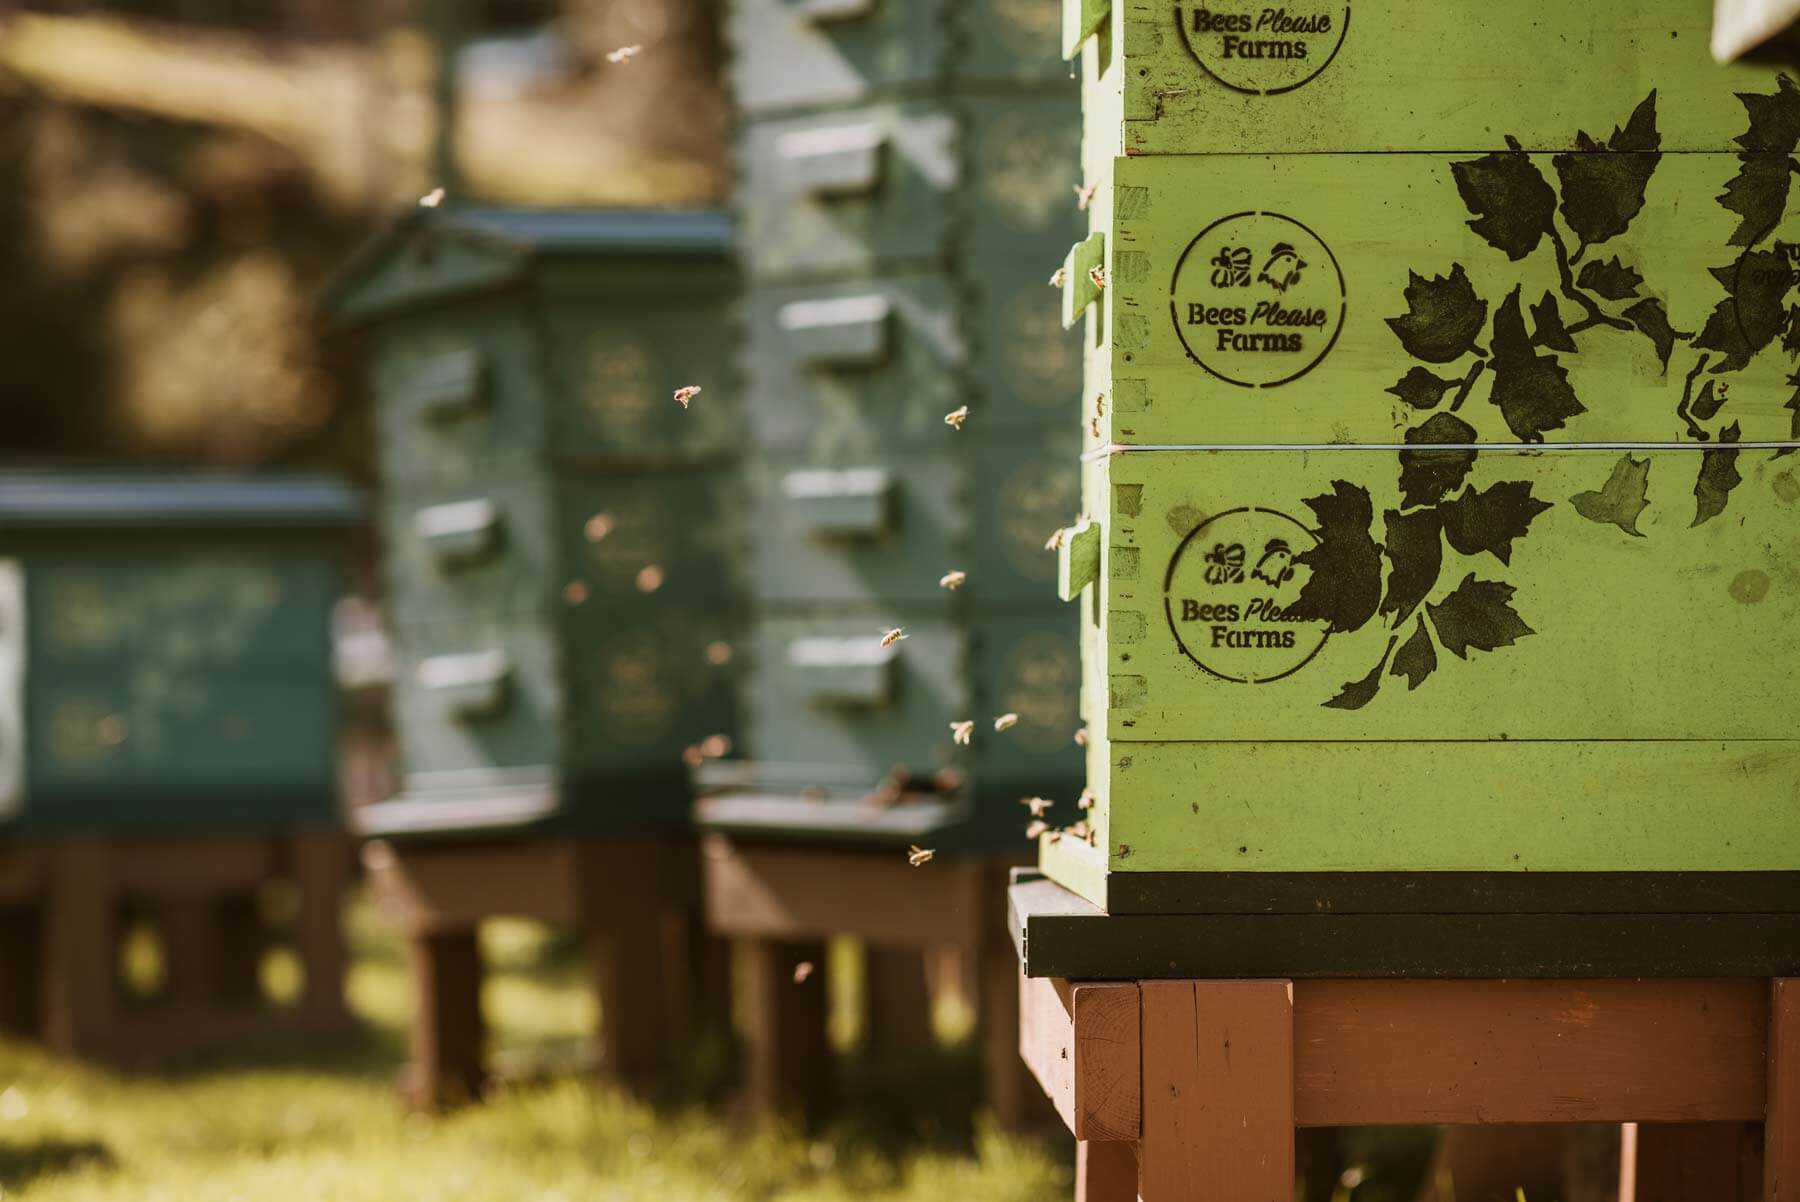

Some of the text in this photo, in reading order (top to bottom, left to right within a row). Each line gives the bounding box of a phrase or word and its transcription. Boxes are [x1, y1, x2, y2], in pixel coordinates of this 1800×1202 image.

[1193, 8, 1332, 34] Bees Please
[1222, 35, 1308, 59] Farms
[1187, 301, 1327, 327] Bees Please
[1216, 328, 1303, 352] Farms
[1180, 599, 1240, 622] Bees
[1210, 626, 1296, 648] Farms
